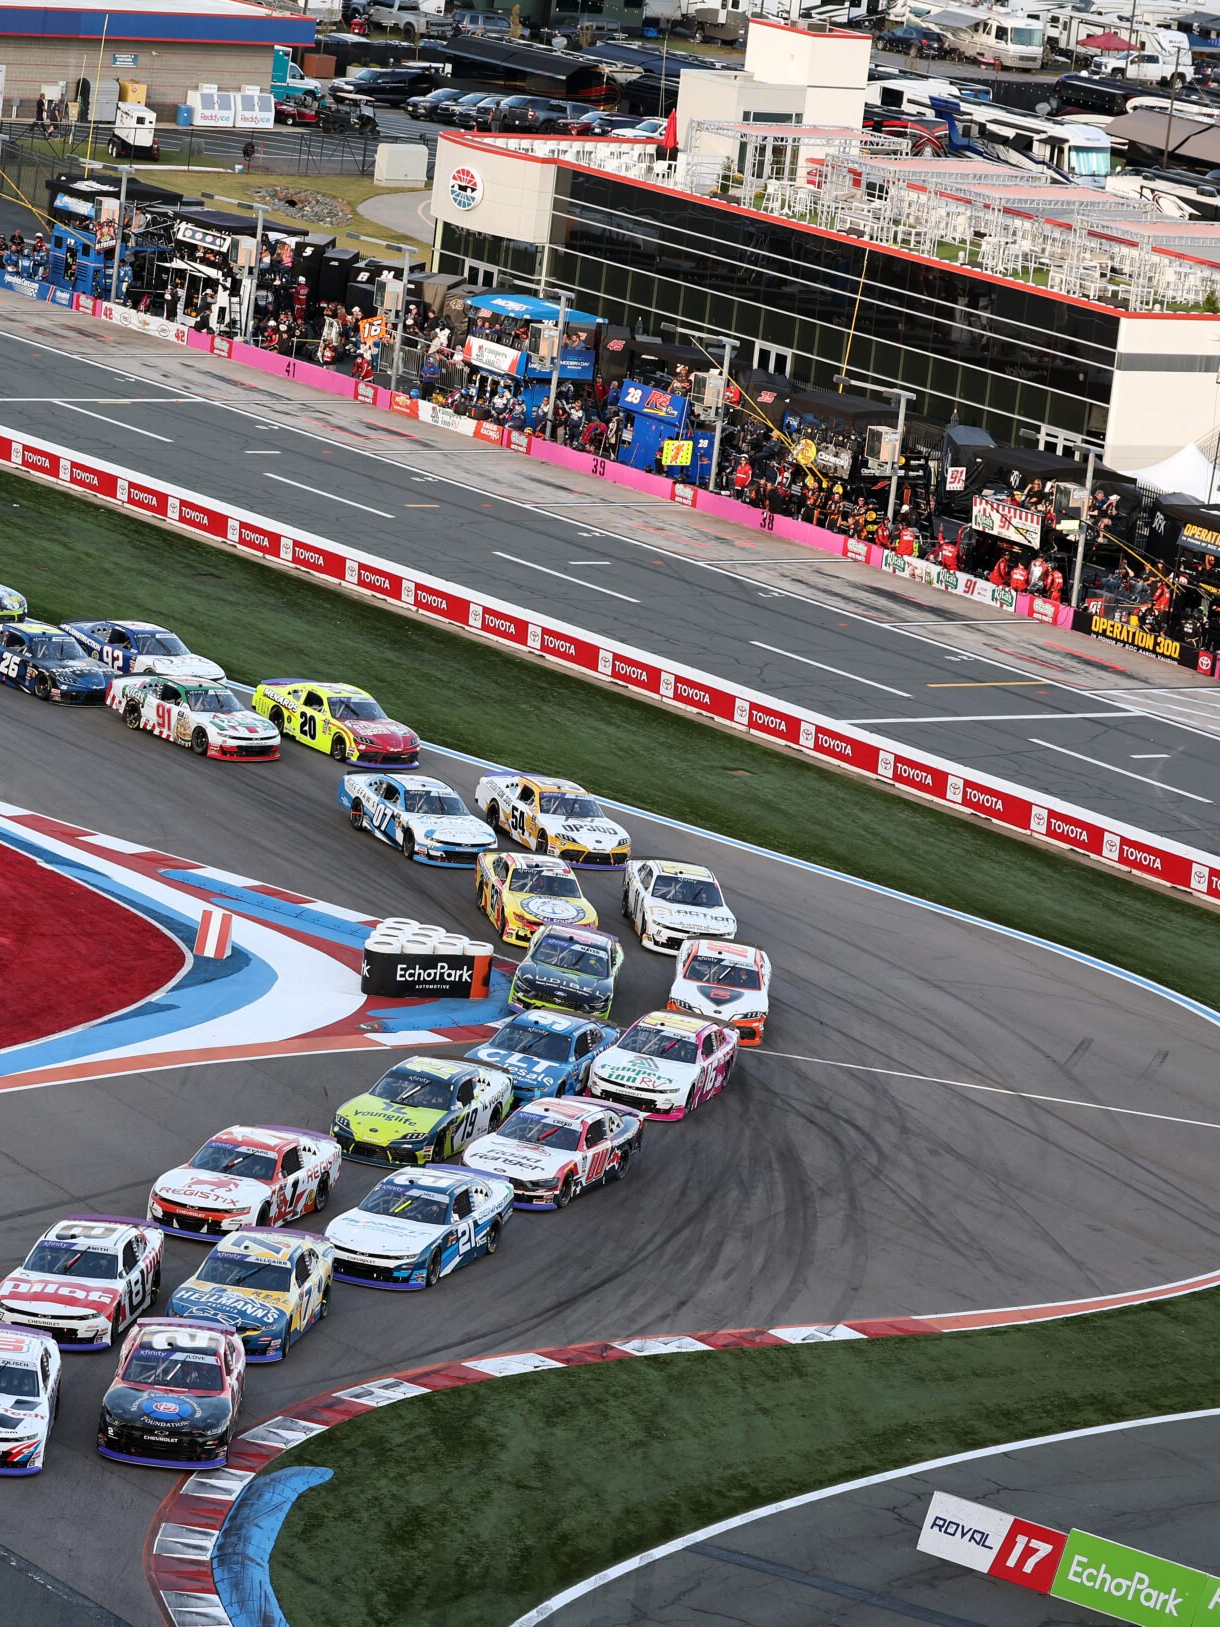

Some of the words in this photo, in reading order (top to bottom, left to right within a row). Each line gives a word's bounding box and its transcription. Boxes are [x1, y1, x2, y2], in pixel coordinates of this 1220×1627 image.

[302, 247, 314, 256] 5
[103, 306, 112, 317] 42
[174, 329, 186, 341] 42
[363, 318, 382, 338] 16
[607, 340, 626, 352] 45
[285, 361, 296, 378] 41
[624, 388, 642, 404] 28
[758, 391, 777, 404] 35
[24, 450, 50, 469] TOYOTA
[592, 458, 606, 475] 39
[72, 467, 98, 486] TOYOTA
[949, 469, 965, 484] 91
[130, 488, 157, 507] TOYOTA
[181, 506, 208, 526] TOYOTA
[760, 512, 774, 530] 38
[998, 514, 1012, 530] 91
[240, 528, 269, 548] TOYOTA
[294, 546, 324, 567] TOYOTA
[886, 551, 905, 568] Rita's
[360, 569, 390, 590] TOYOTA
[938, 568, 958, 585] Rita's
[963, 579, 976, 596] 91
[992, 586, 1012, 603] Rita's
[416, 590, 447, 611] TOYOTA
[484, 613, 515, 636] TOYOTA
[543, 634, 575, 656] TOYOTA
[1092, 616, 1155, 650] OPERATION
[1156, 634, 1180, 658] 300
[1098, 634, 1116, 646] HONOR
[1138, 648, 1156, 659] AARON
[0, 652, 22, 678] 26
[104, 646, 124, 672] 92
[614, 660, 647, 682] TOYOTA
[264, 688, 298, 712] MENARDS
[676, 682, 710, 705] TOYOTA
[156, 703, 172, 732] 91
[300, 710, 316, 740] 20
[752, 710, 786, 733] TOYOTA
[817, 733, 852, 757] TOYOTA
[896, 762, 932, 786] TOYOTA
[965, 787, 1003, 812] TOYOTA
[372, 804, 392, 831] 07
[510, 804, 526, 835] 54
[1049, 818, 1088, 843] TOYOTA
[1122, 844, 1162, 870] TOYOTA
[546, 938, 570, 947] xfinity
[580, 946, 600, 955] MAYER
[396, 962, 473, 982] EchoPark
[528, 1027, 548, 1036] xfinity
[477, 1050, 558, 1073] CLT
[408, 1075, 430, 1083] xfinity
[600, 1063, 674, 1084] campers
[607, 1071, 638, 1084] inn
[640, 1077, 669, 1088] RV
[703, 1060, 718, 1092] 16
[354, 1109, 418, 1127] younglife
[461, 1106, 478, 1142] 19
[520, 1112, 540, 1120] xfinity
[553, 1118, 573, 1128] CREED
[246, 1148, 269, 1156] KVAPIL
[470, 1152, 546, 1172] Ranger
[485, 1148, 542, 1164] Road
[584, 1150, 608, 1182] 00
[158, 1186, 240, 1207] REGISTIX
[288, 1178, 300, 1210] 1
[381, 1184, 404, 1192] xfinity
[176, 1209, 204, 1217] CHEVROLET
[458, 1220, 476, 1256] 21
[217, 1252, 241, 1260] xfinity
[255, 1257, 288, 1266] ALLGAIER
[346, 1256, 376, 1264] CHEVROLET
[2, 1360, 29, 1368] ZILISCH
[108, 1428, 114, 1436] 2
[140, 1416, 190, 1428] FOUNDATION
[144, 1435, 178, 1443] CHEVROLET
[1005, 1534, 1054, 1574] 17
[1067, 1554, 1184, 1617] EchoPark
